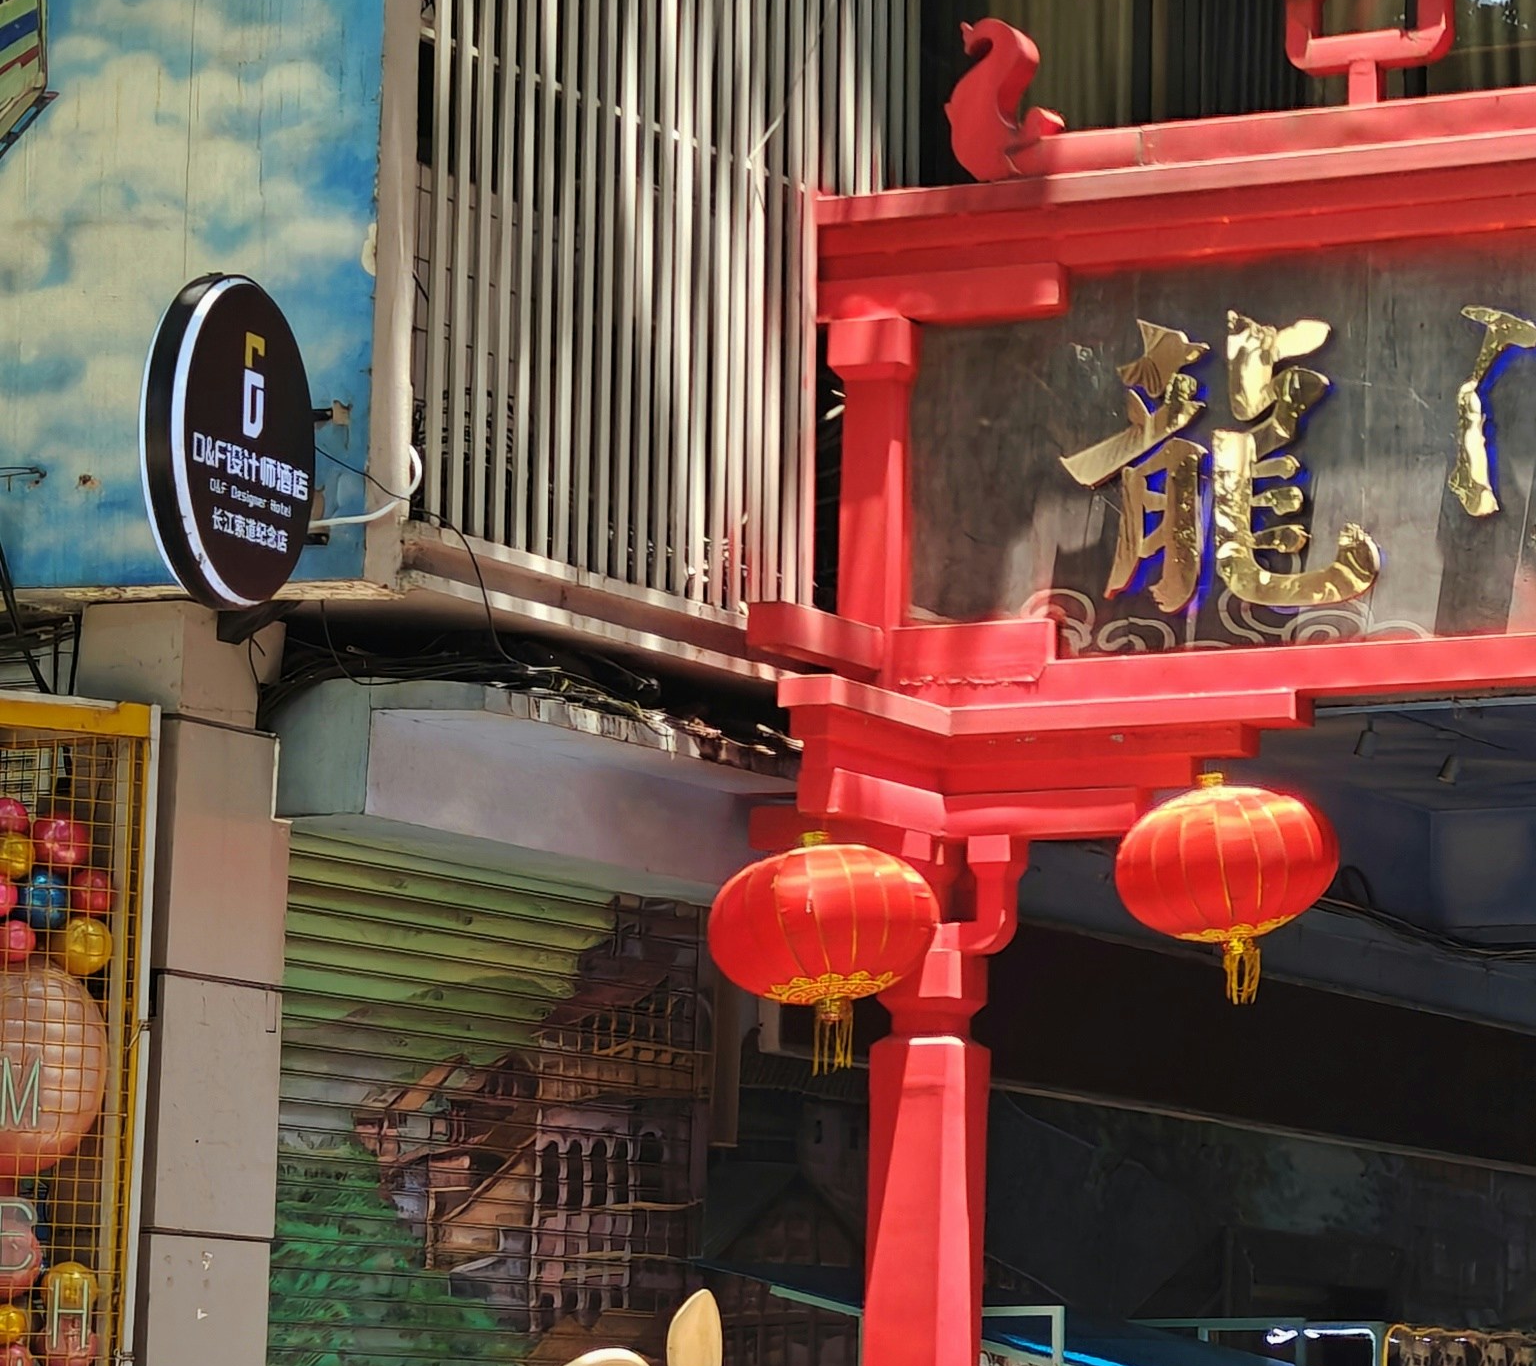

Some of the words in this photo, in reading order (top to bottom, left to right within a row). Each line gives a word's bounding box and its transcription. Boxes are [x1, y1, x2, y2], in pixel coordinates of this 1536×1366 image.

[192, 431, 309, 501] D&F设计师酒店
[211, 506, 289, 553] 长江索道纪念店
